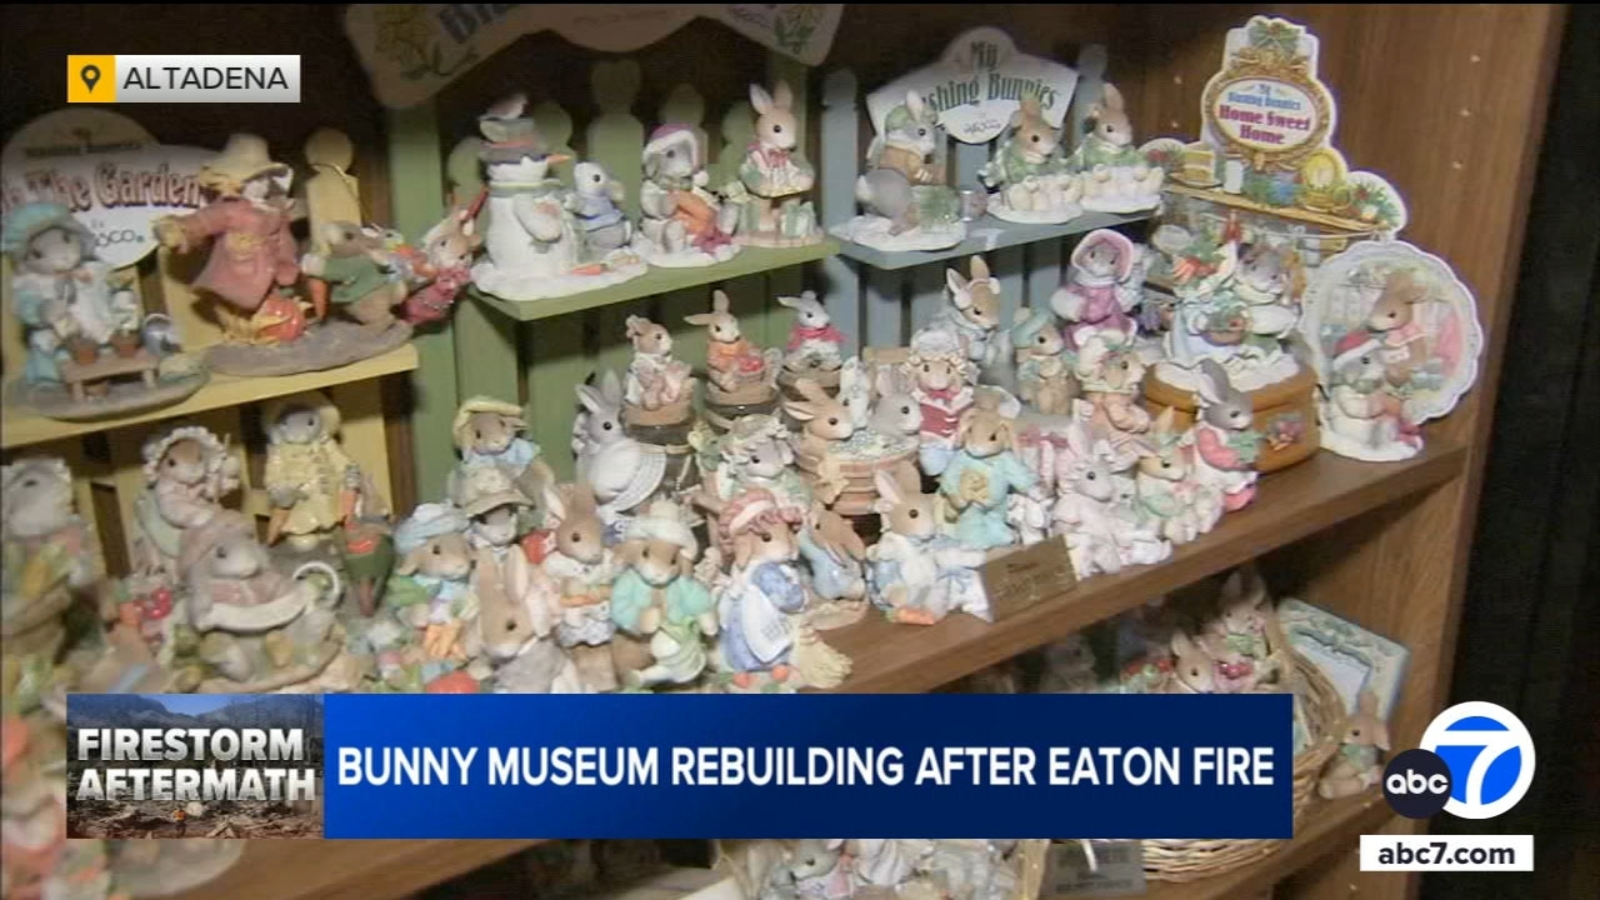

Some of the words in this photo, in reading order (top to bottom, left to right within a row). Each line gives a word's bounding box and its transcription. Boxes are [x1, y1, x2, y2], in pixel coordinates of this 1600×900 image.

[921, 75, 981, 112] shing
[1219, 104, 1264, 125] Home
[1266, 111, 1311, 131] Sweet
[1239, 123, 1286, 145] Home
[95, 161, 200, 210] Garden
